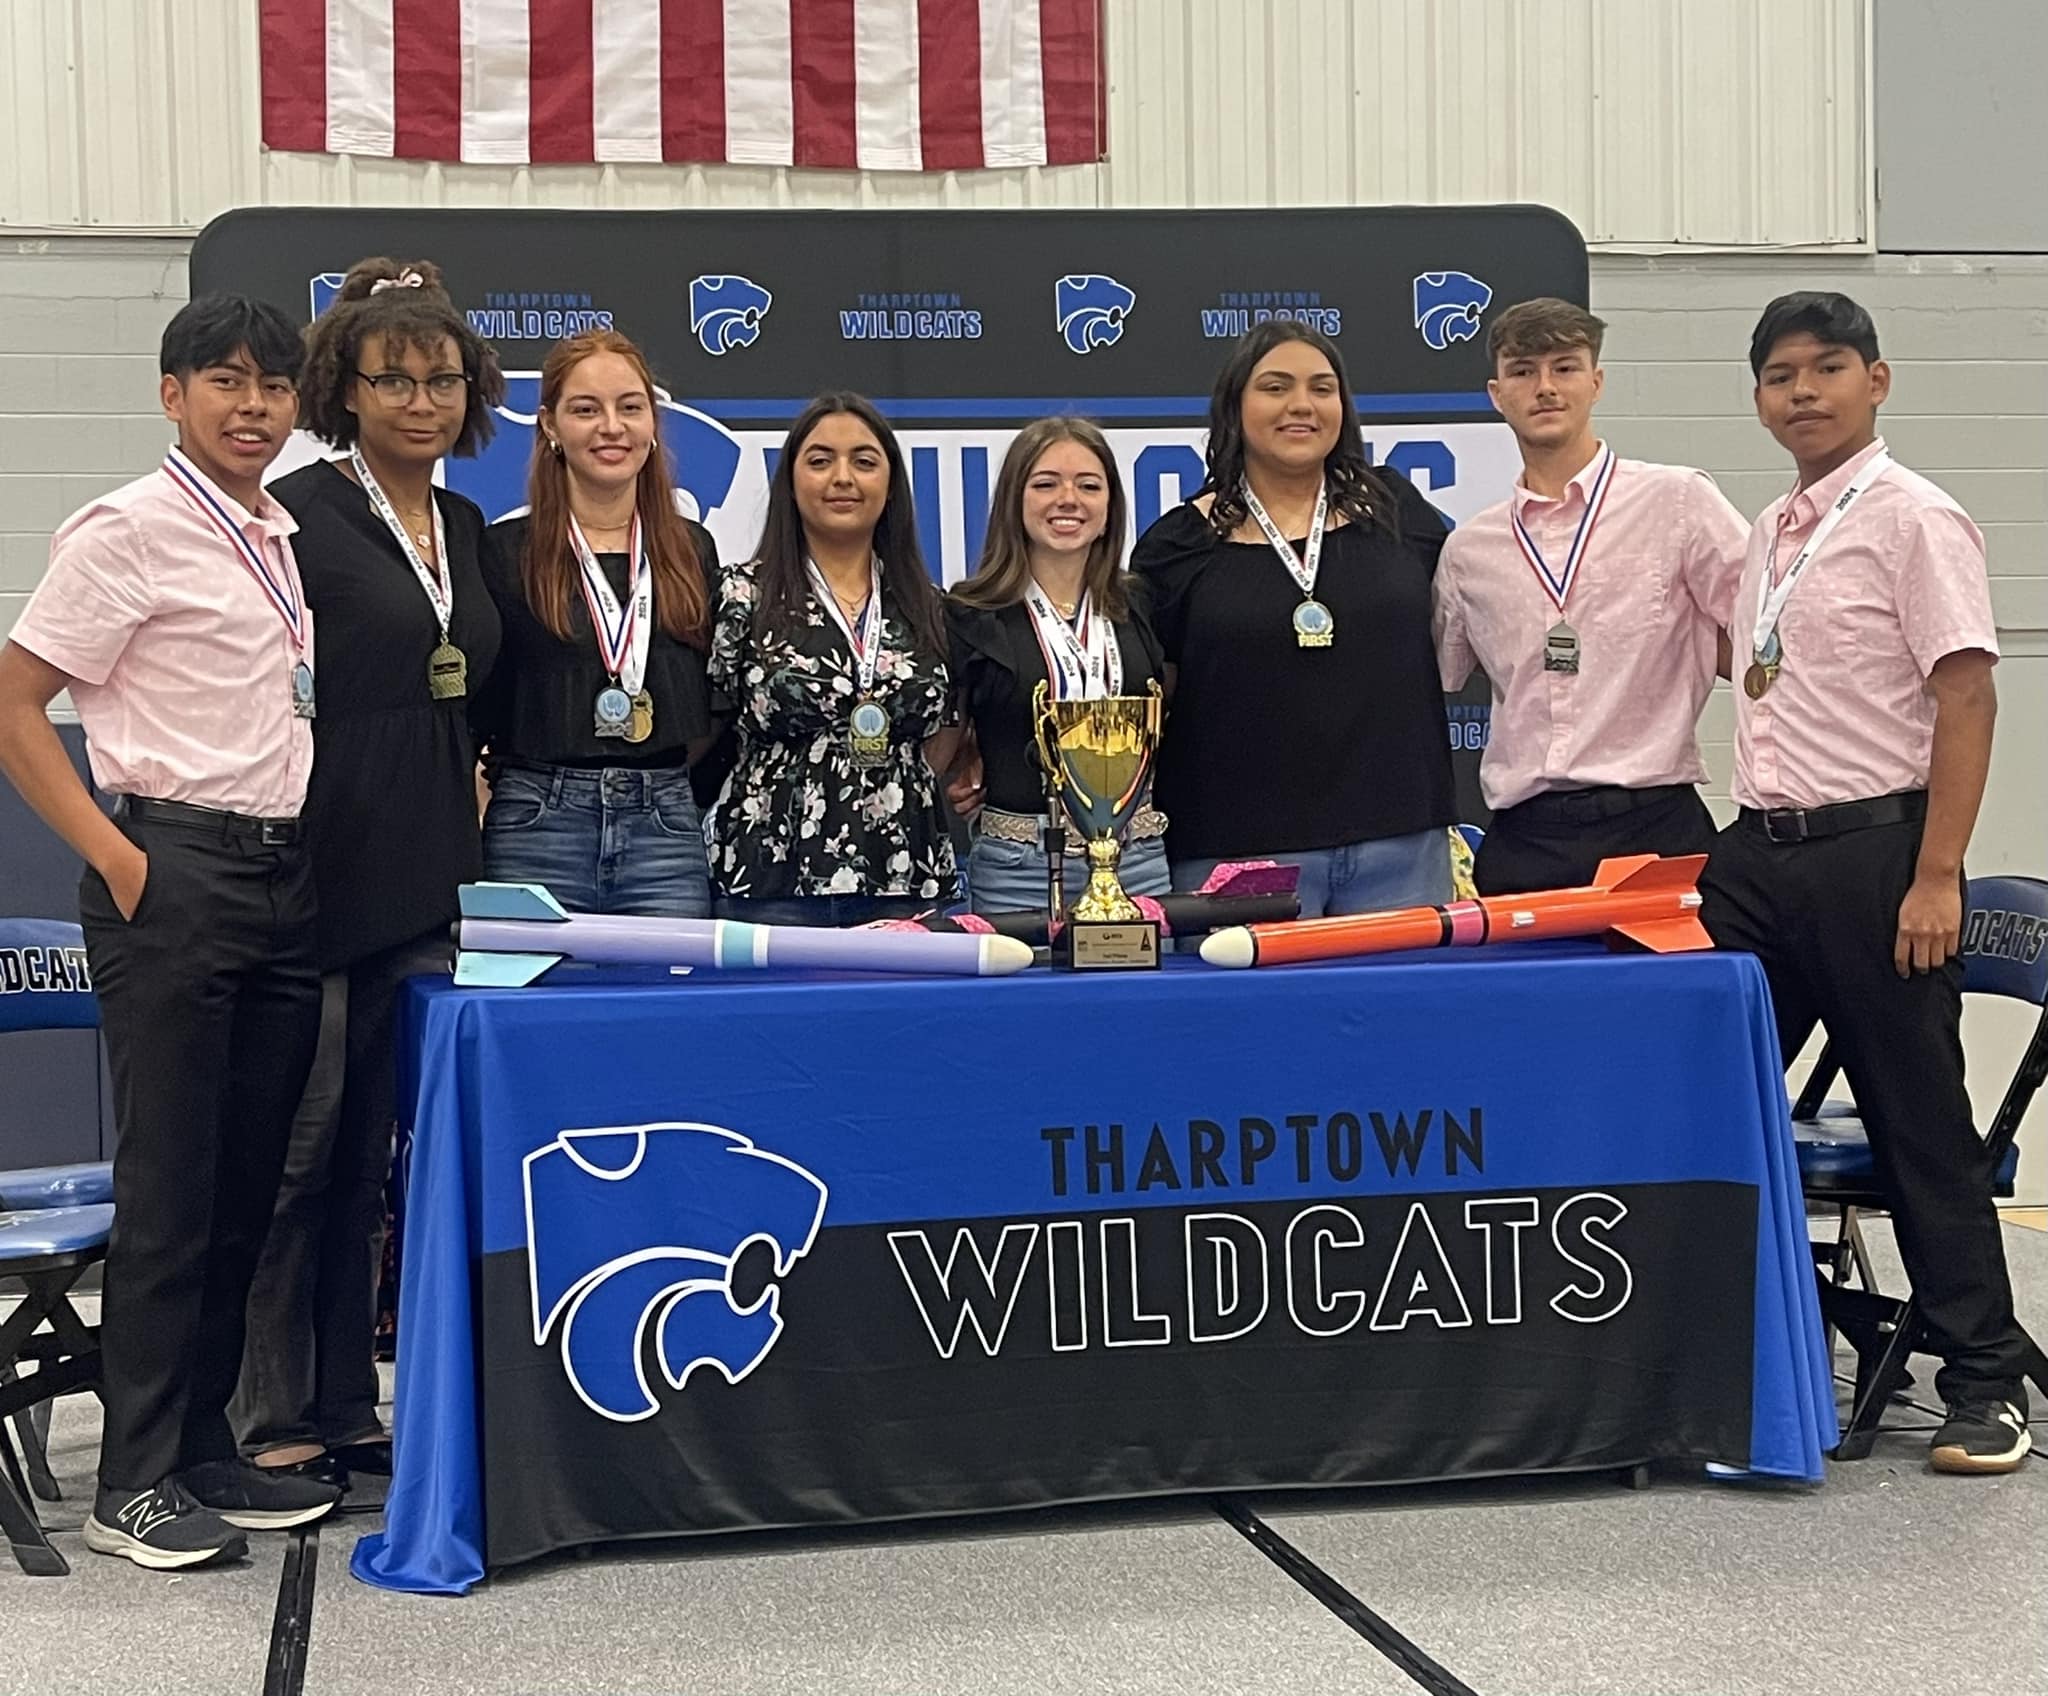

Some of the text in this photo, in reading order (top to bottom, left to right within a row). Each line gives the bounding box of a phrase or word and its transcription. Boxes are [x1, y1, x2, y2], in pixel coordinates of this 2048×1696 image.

[485, 292, 592, 308] THARPTOWN
[858, 293, 961, 308] THARPTOWN
[1220, 291, 1320, 307] THARPTOWN
[467, 310, 614, 339] WILDCATS
[840, 310, 982, 339] WILDCATS
[1834, 488, 1858, 511] 2024
[1041, 1106, 1485, 1197] THARPTOWN
[886, 1192, 1635, 1359] WILDCATS
